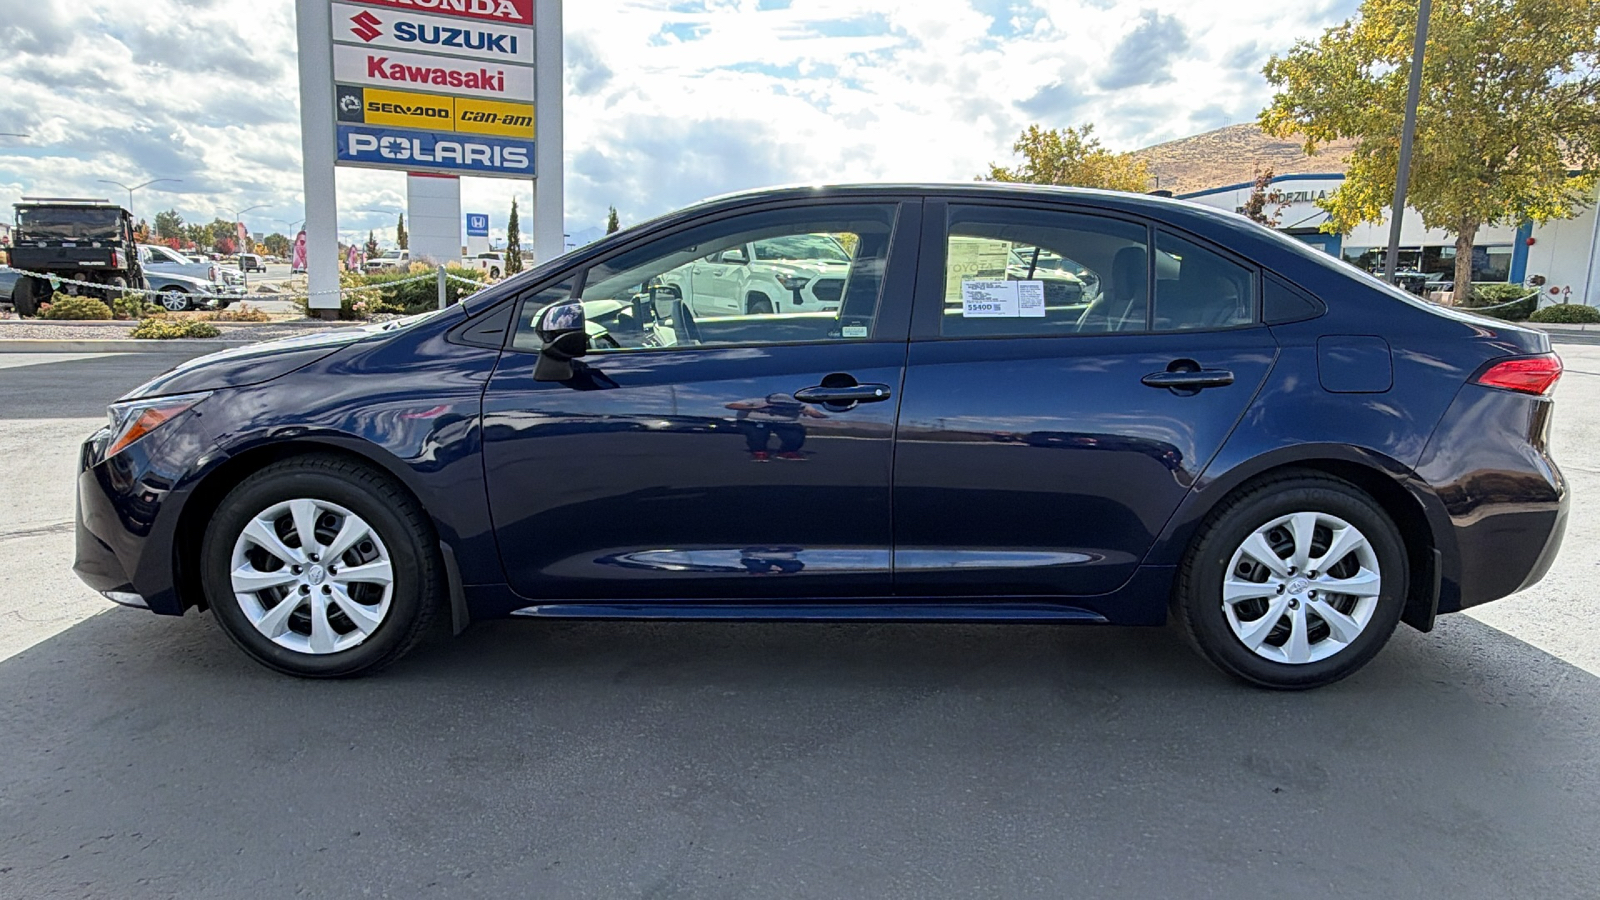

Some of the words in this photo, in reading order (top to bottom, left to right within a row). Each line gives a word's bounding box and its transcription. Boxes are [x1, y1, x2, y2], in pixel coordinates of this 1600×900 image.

[386, 0, 523, 20] NDA
[393, 21, 518, 54] SUZUKI
[367, 55, 505, 92] Kawasaki
[460, 110, 533, 127] can-am
[347, 133, 530, 169] POLARIS
